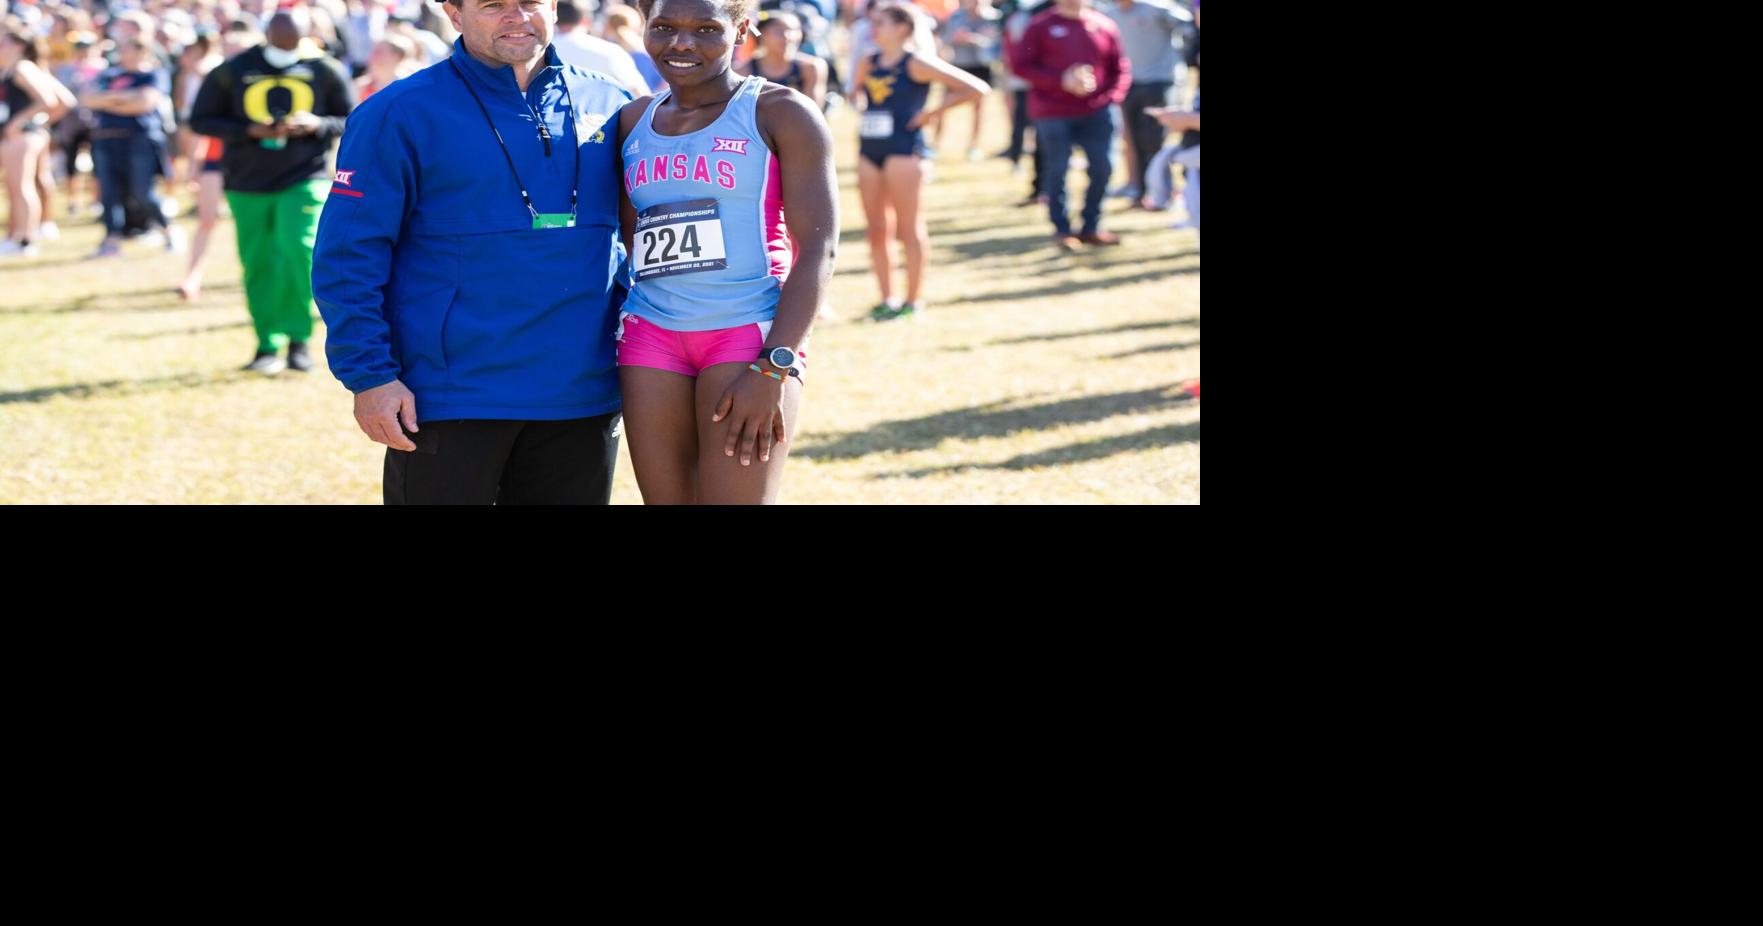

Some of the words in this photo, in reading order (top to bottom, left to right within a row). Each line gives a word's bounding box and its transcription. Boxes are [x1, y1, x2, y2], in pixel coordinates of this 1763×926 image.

[713, 137, 748, 155] XII
[669, 209, 715, 219] CHAMPIONSHIPS
[643, 224, 702, 266] 224
